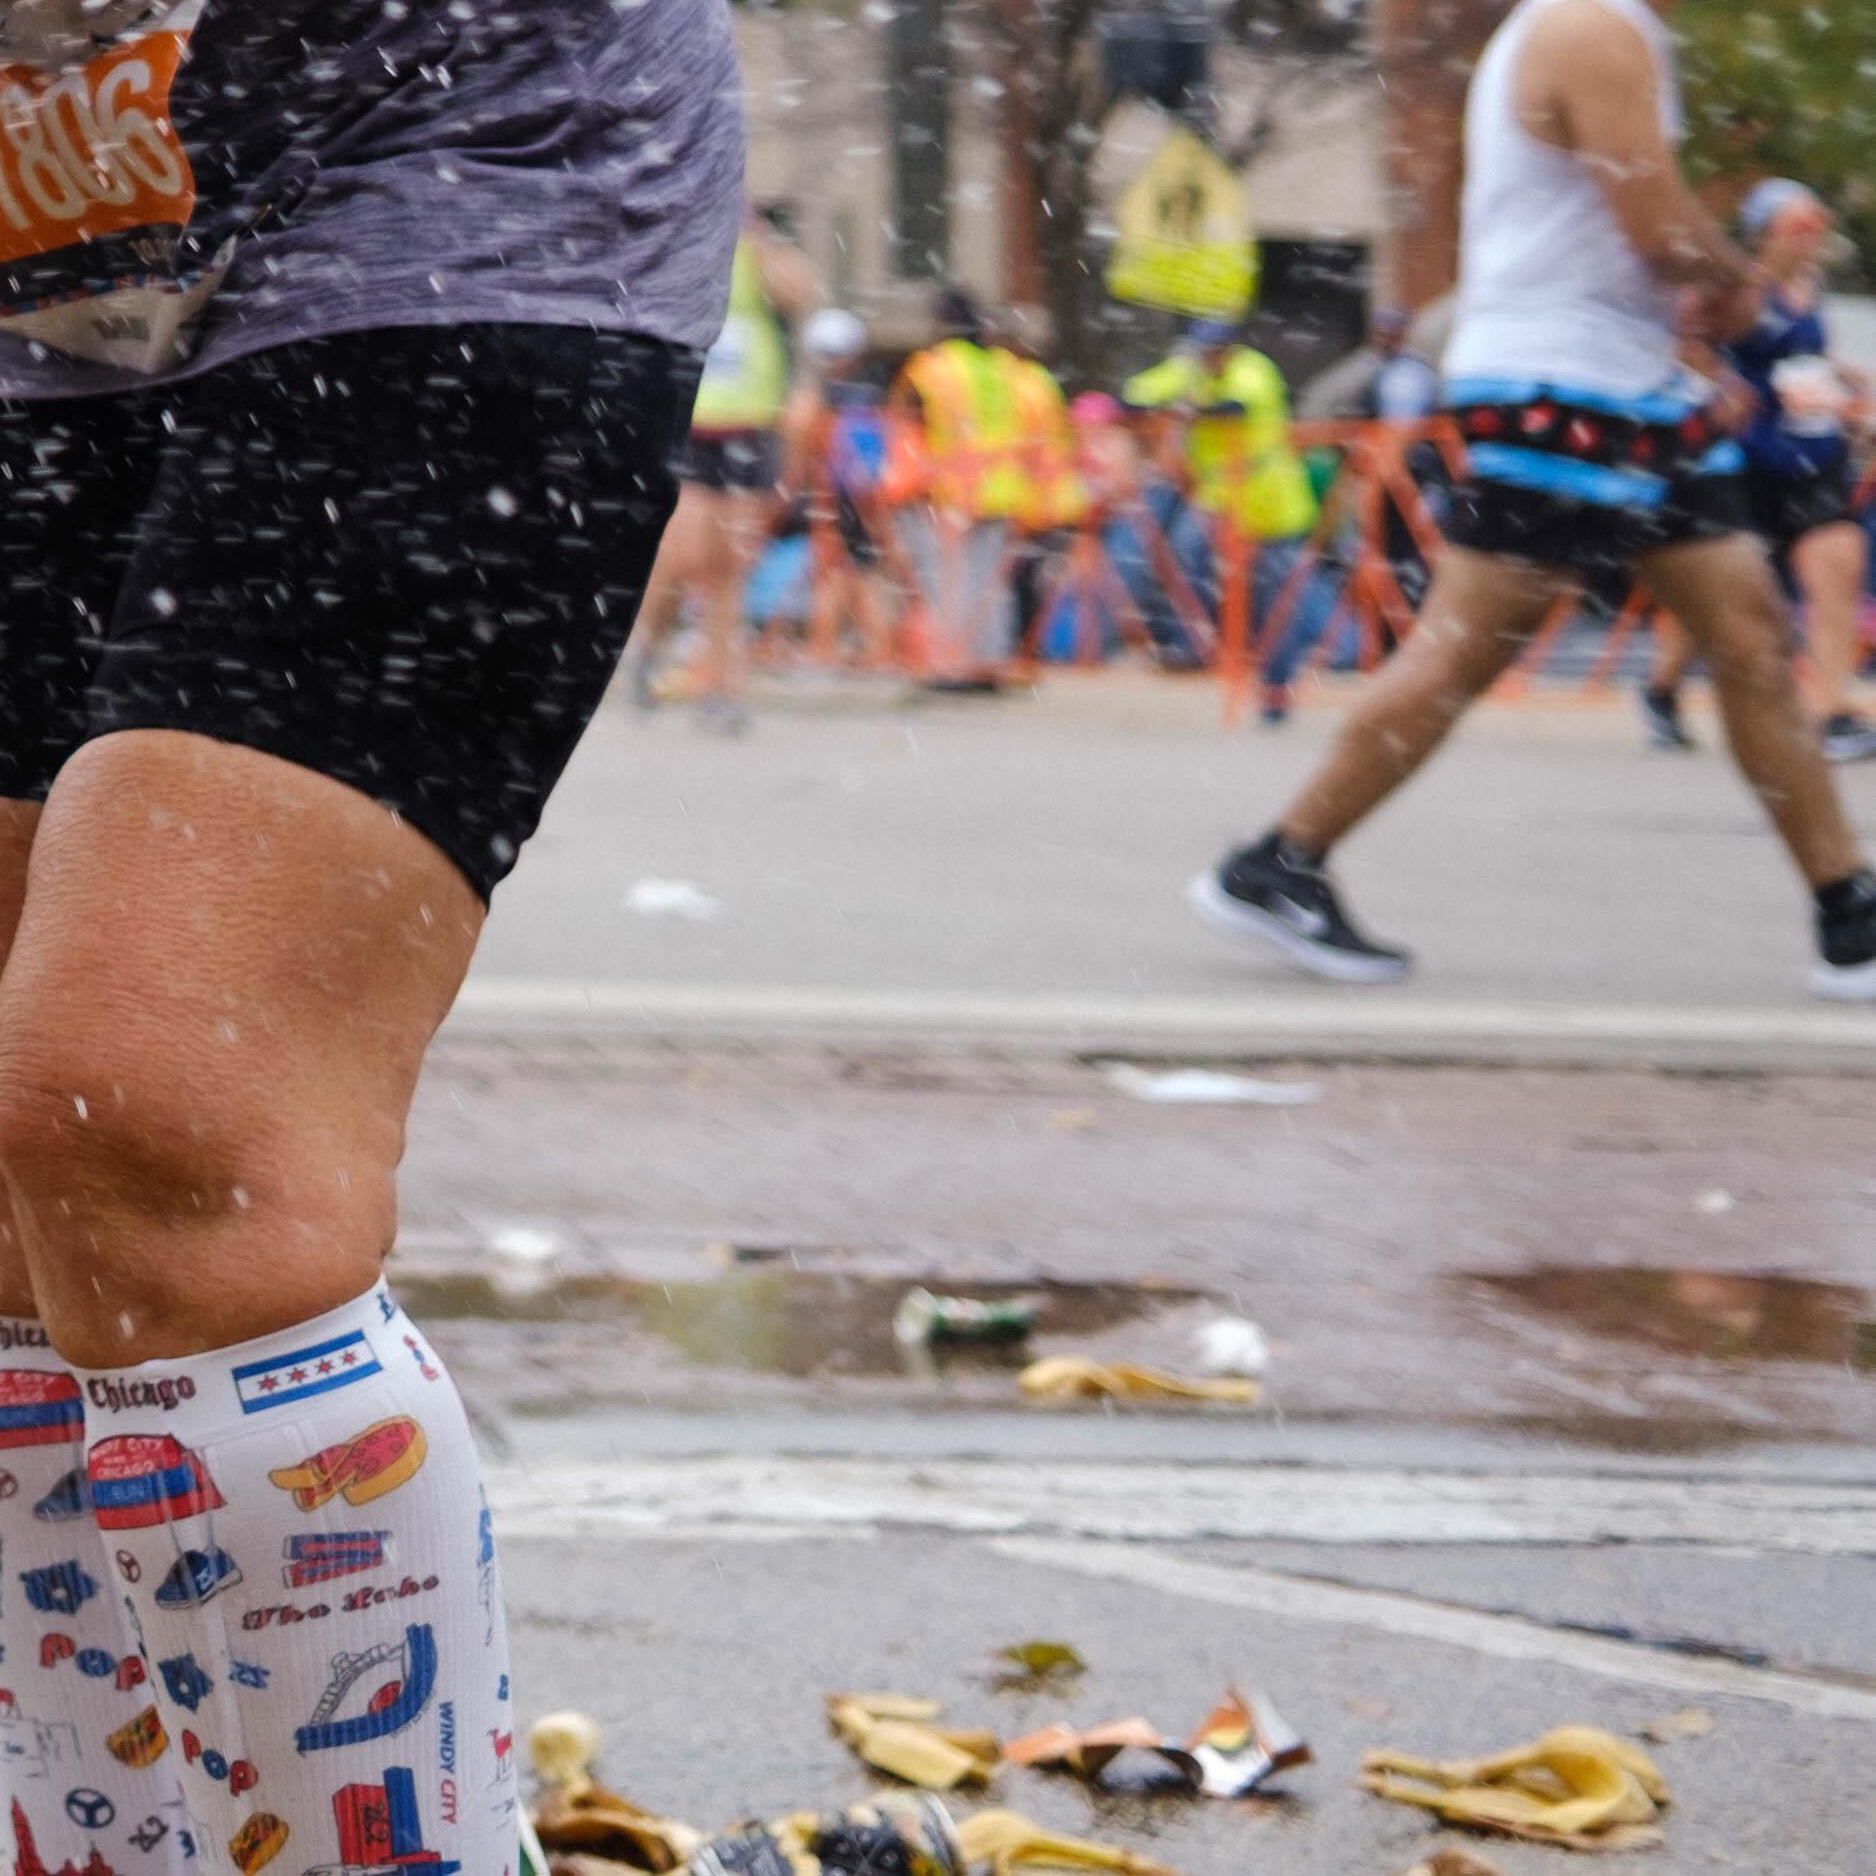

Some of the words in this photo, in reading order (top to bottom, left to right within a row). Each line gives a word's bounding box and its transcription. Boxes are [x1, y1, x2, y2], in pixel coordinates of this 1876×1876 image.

[87, 1374, 197, 1414] Chicago
[438, 1700, 456, 1775] WINDY
[440, 1778, 457, 1824] CITY
